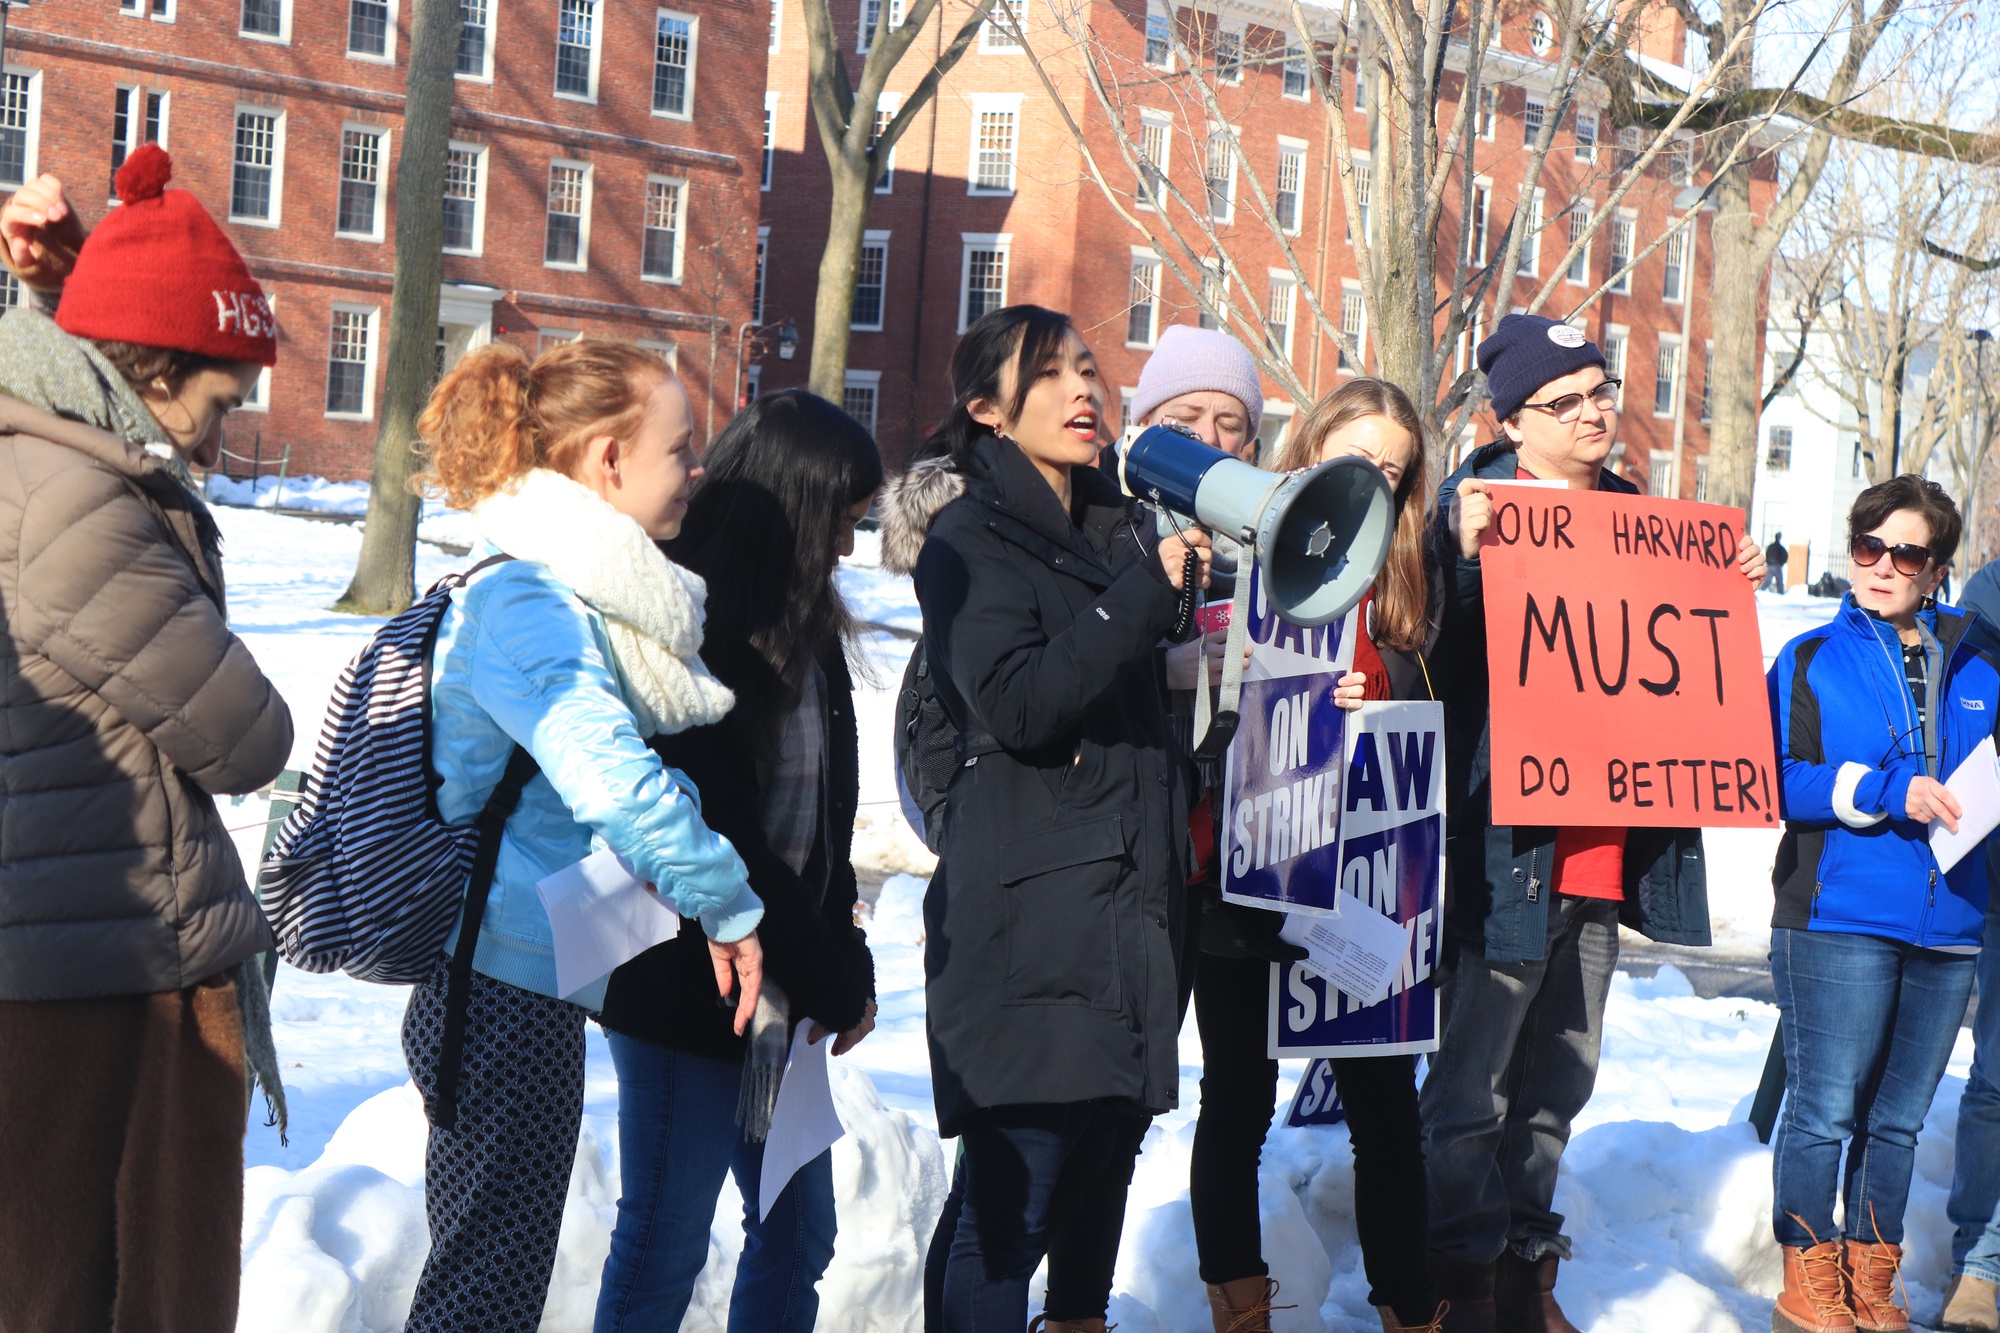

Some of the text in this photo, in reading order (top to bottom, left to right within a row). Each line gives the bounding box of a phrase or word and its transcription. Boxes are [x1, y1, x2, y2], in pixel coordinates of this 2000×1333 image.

[1497, 502, 1738, 570] OUR HARVARD
[1519, 592, 1730, 706] MUST
[1269, 690, 1310, 777] ON
[1346, 731, 1436, 812] AW
[1232, 768, 1339, 879] STRIKE
[1520, 755, 1774, 823] DO BETTER!
[1342, 843, 1397, 916] ON
[1288, 908, 1433, 1033] SKE
